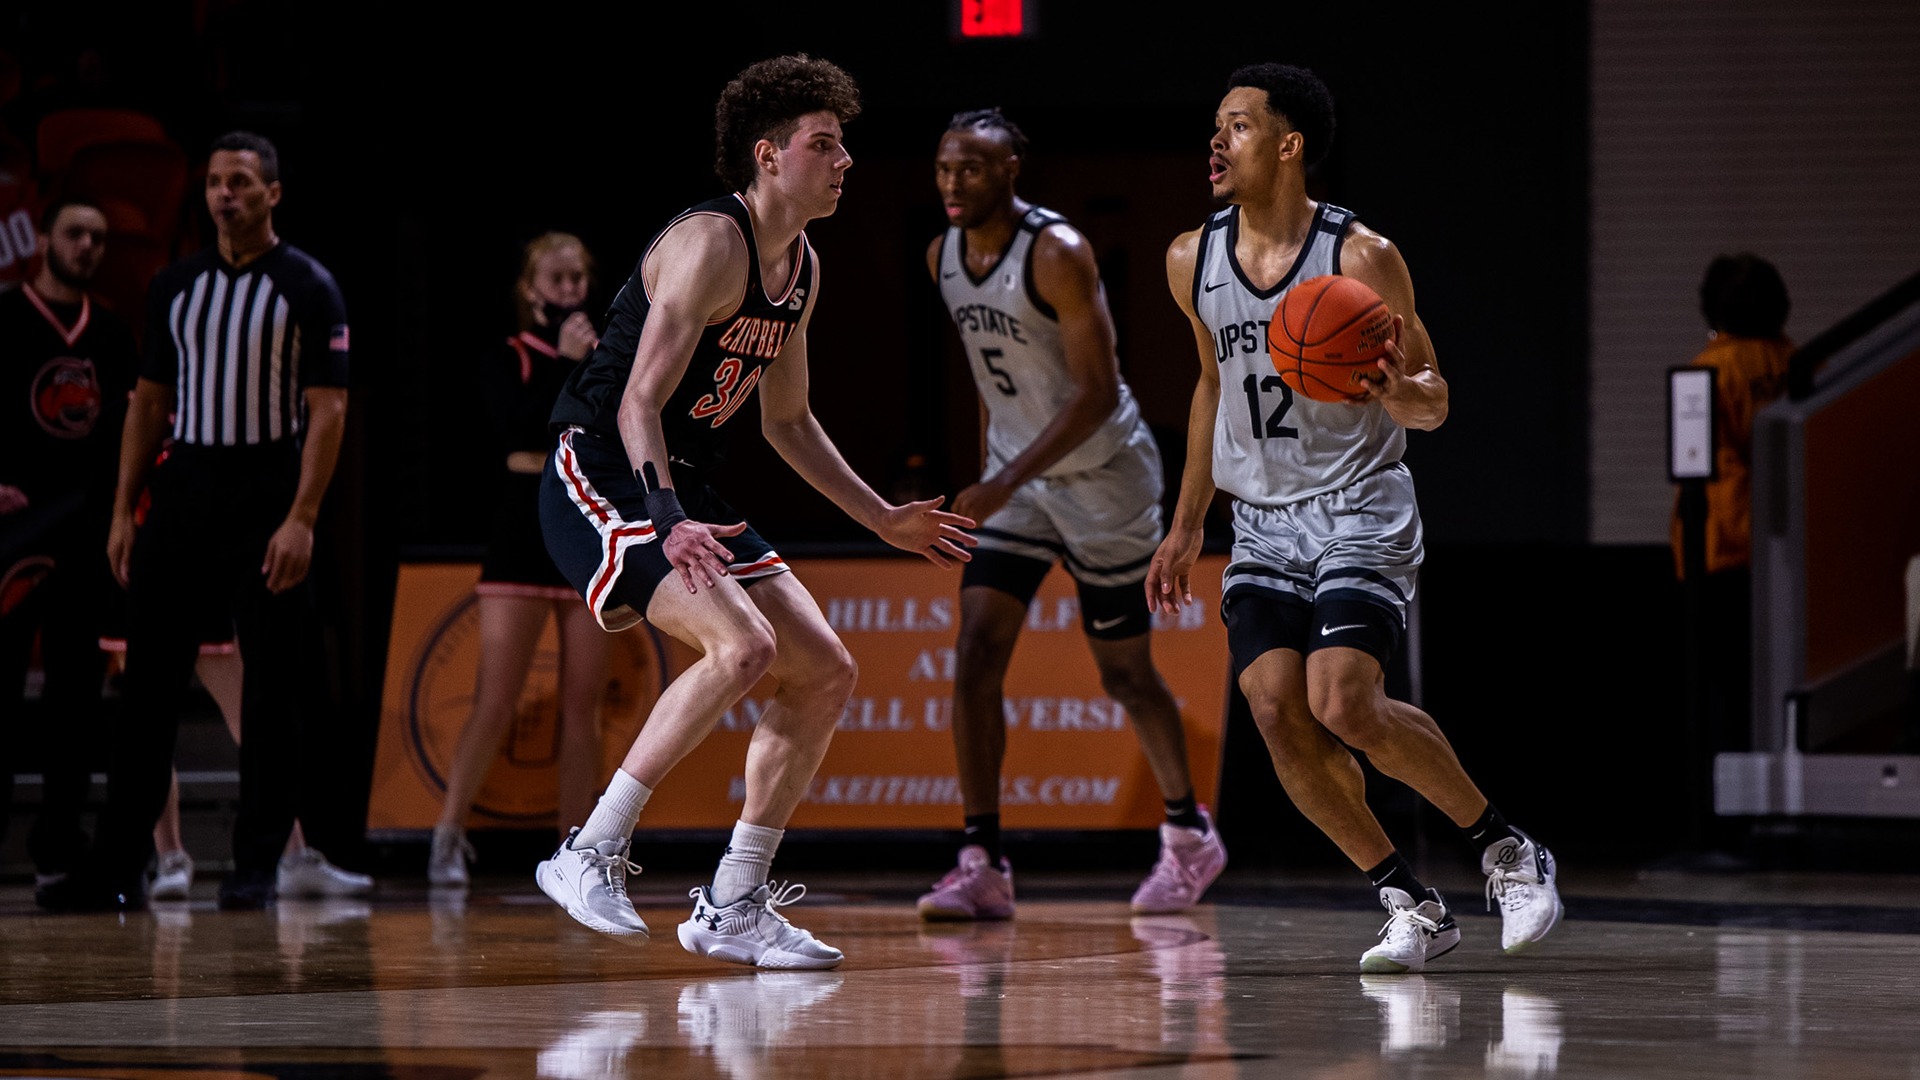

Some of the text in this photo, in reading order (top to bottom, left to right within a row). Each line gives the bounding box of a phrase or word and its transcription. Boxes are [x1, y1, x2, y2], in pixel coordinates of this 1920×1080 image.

[953, 304, 1028, 345] PSTATE
[1214, 320, 1270, 363] UPST
[688, 357, 761, 428] 30
[981, 348, 1017, 396] 5
[1243, 373, 1299, 439] 12
[827, 597, 953, 632] HILLS
[1028, 597, 1079, 632] LF
